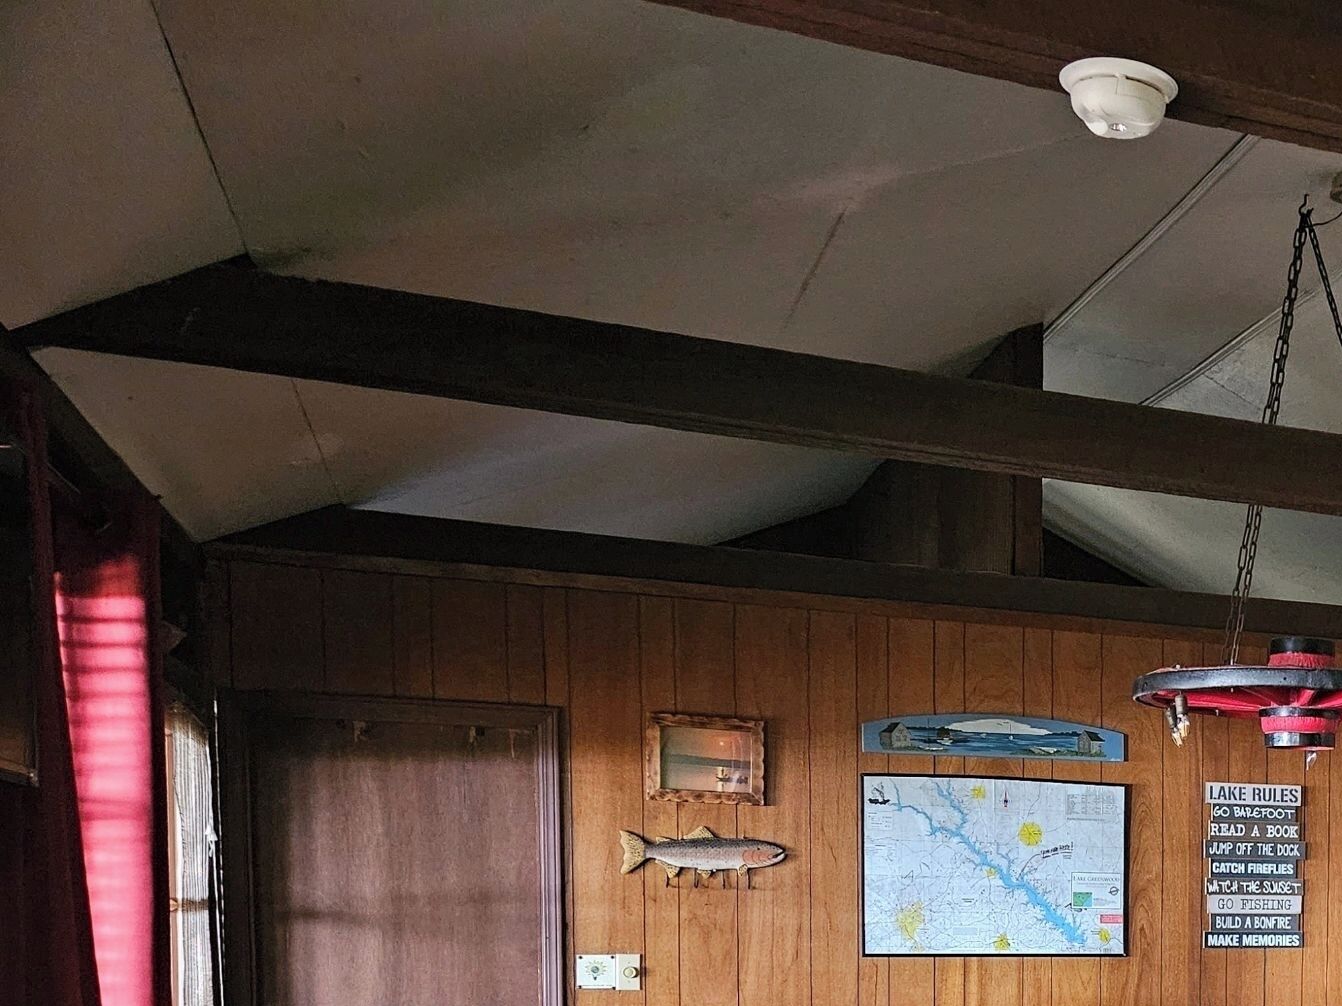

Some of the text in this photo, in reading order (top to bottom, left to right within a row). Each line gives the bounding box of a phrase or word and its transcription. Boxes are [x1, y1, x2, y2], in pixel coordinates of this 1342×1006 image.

[1209, 786, 1299, 803] LAKE RULES
[1213, 806, 1295, 819] GO BAREFOOT
[1211, 823, 1298, 837] READ A BOOK
[1209, 842, 1300, 856] JUMP OFF THE DOCK
[1213, 862, 1293, 874] CATCH FIREFLIES
[1207, 880, 1301, 894] WATCH THE SUNSET
[1218, 899, 1292, 910] GO FISHING
[1216, 917, 1291, 929] BUILD A BONFIRE
[1208, 934, 1299, 946] MAKE MEMORIES
